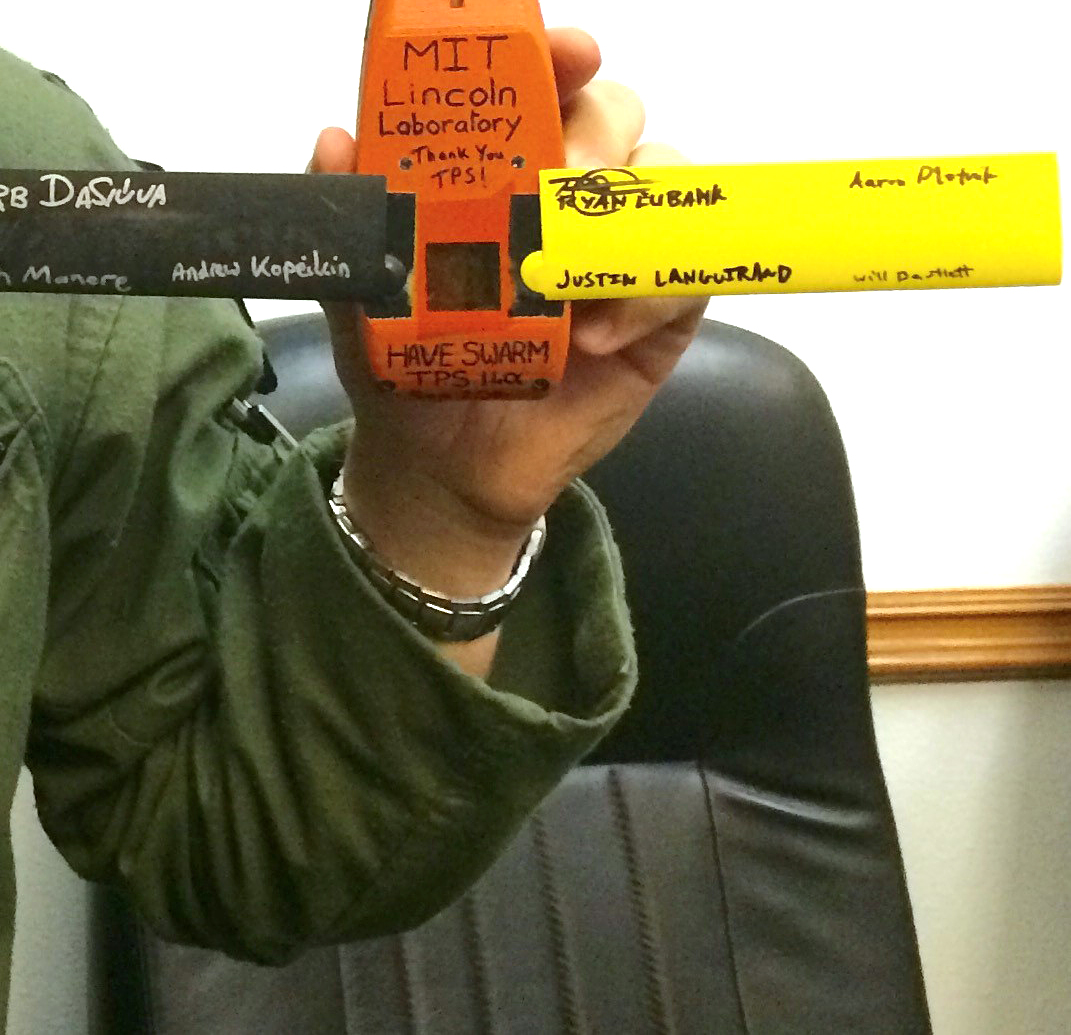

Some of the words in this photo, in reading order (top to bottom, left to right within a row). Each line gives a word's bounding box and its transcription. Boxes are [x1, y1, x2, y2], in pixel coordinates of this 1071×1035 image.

[403, 34, 509, 72] MIT
[382, 77, 517, 108] Lincoln
[378, 110, 522, 142] Laboratory
[412, 145, 470, 165] Thank
[475, 143, 505, 162] You
[431, 166, 488, 189] TPS!
[171, 259, 241, 283] Andrew
[556, 269, 637, 290] JUSTIN
[387, 342, 454, 368] HAVE
[461, 340, 550, 366] SWARM
[406, 370, 471, 388] TPS
